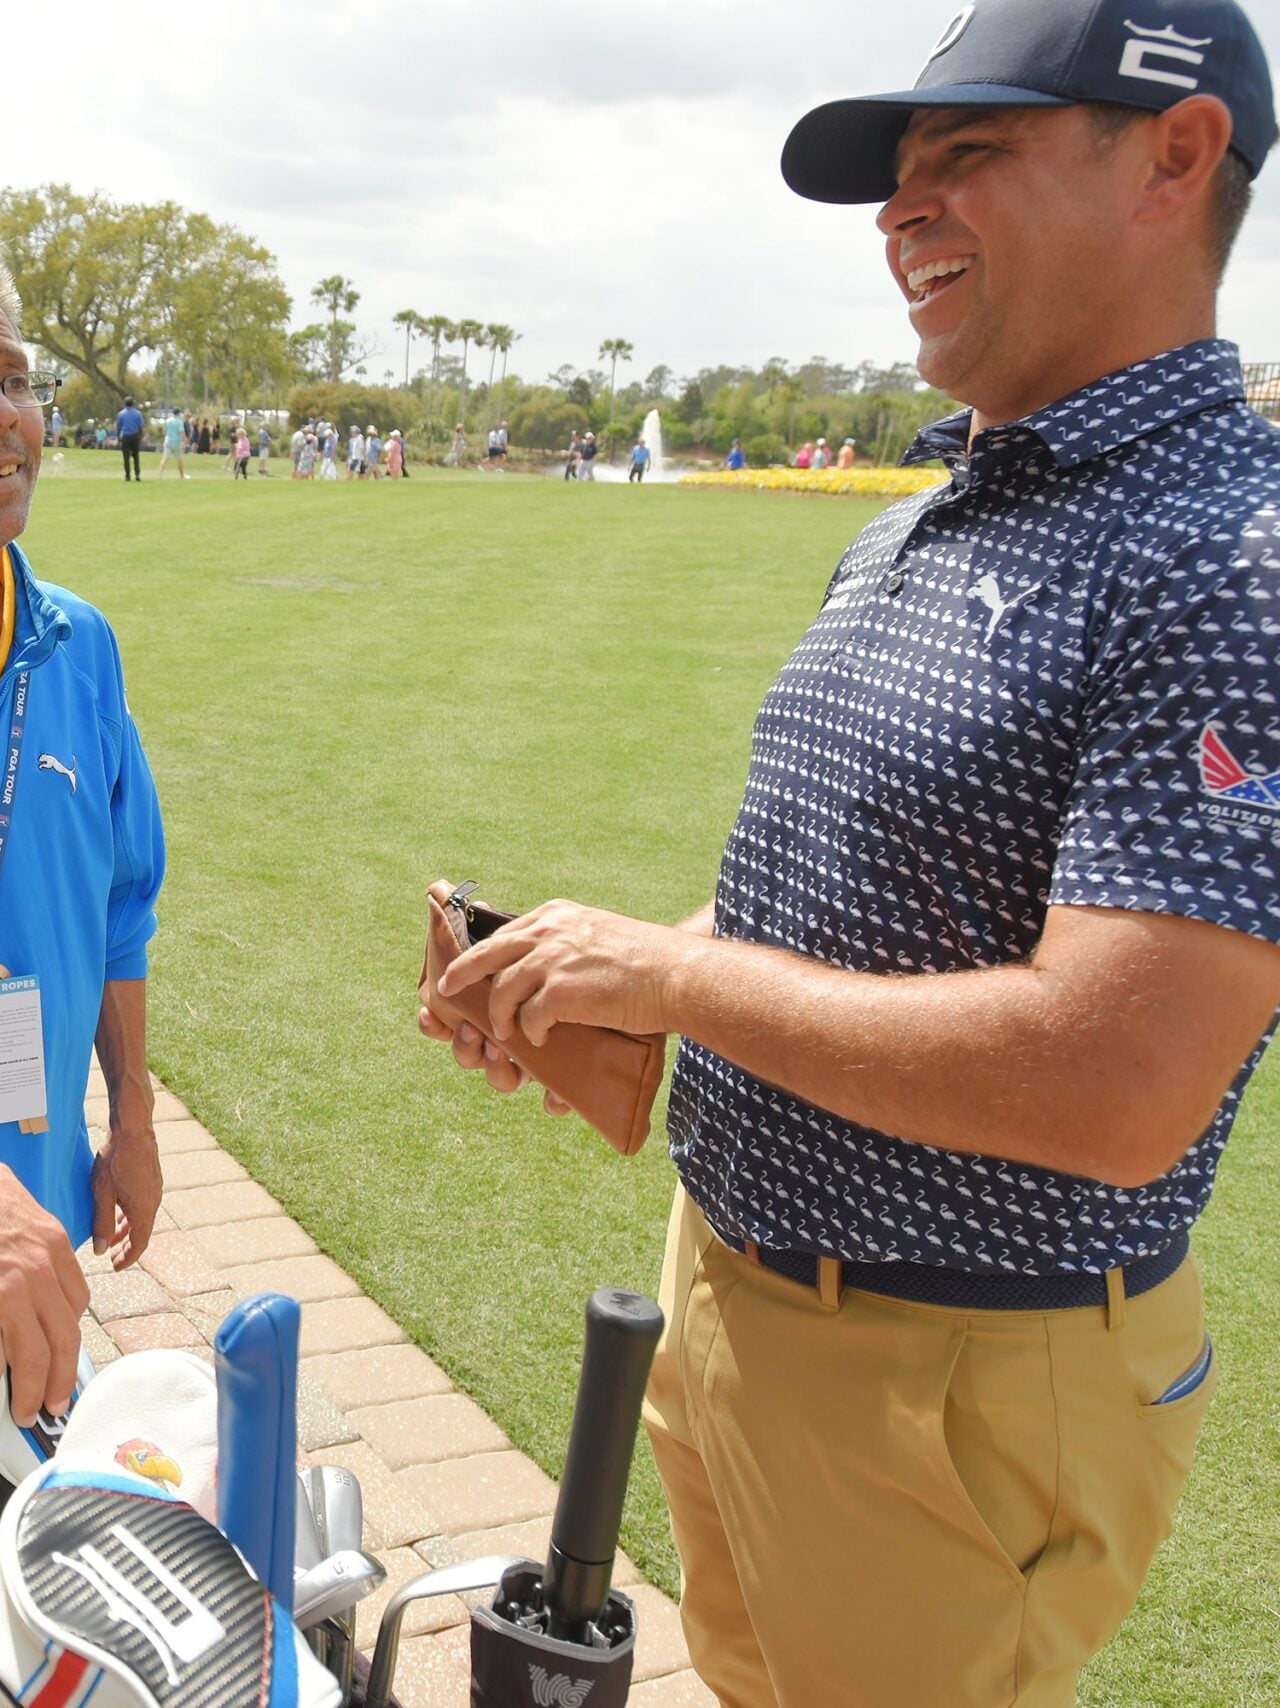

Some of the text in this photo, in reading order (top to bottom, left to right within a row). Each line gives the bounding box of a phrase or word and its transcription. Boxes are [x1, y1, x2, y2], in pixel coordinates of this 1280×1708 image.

[15, 687, 26, 717] TOUR
[2, 748, 19, 805] PGA TOUR
[1, 979, 36, 992] ROPES
